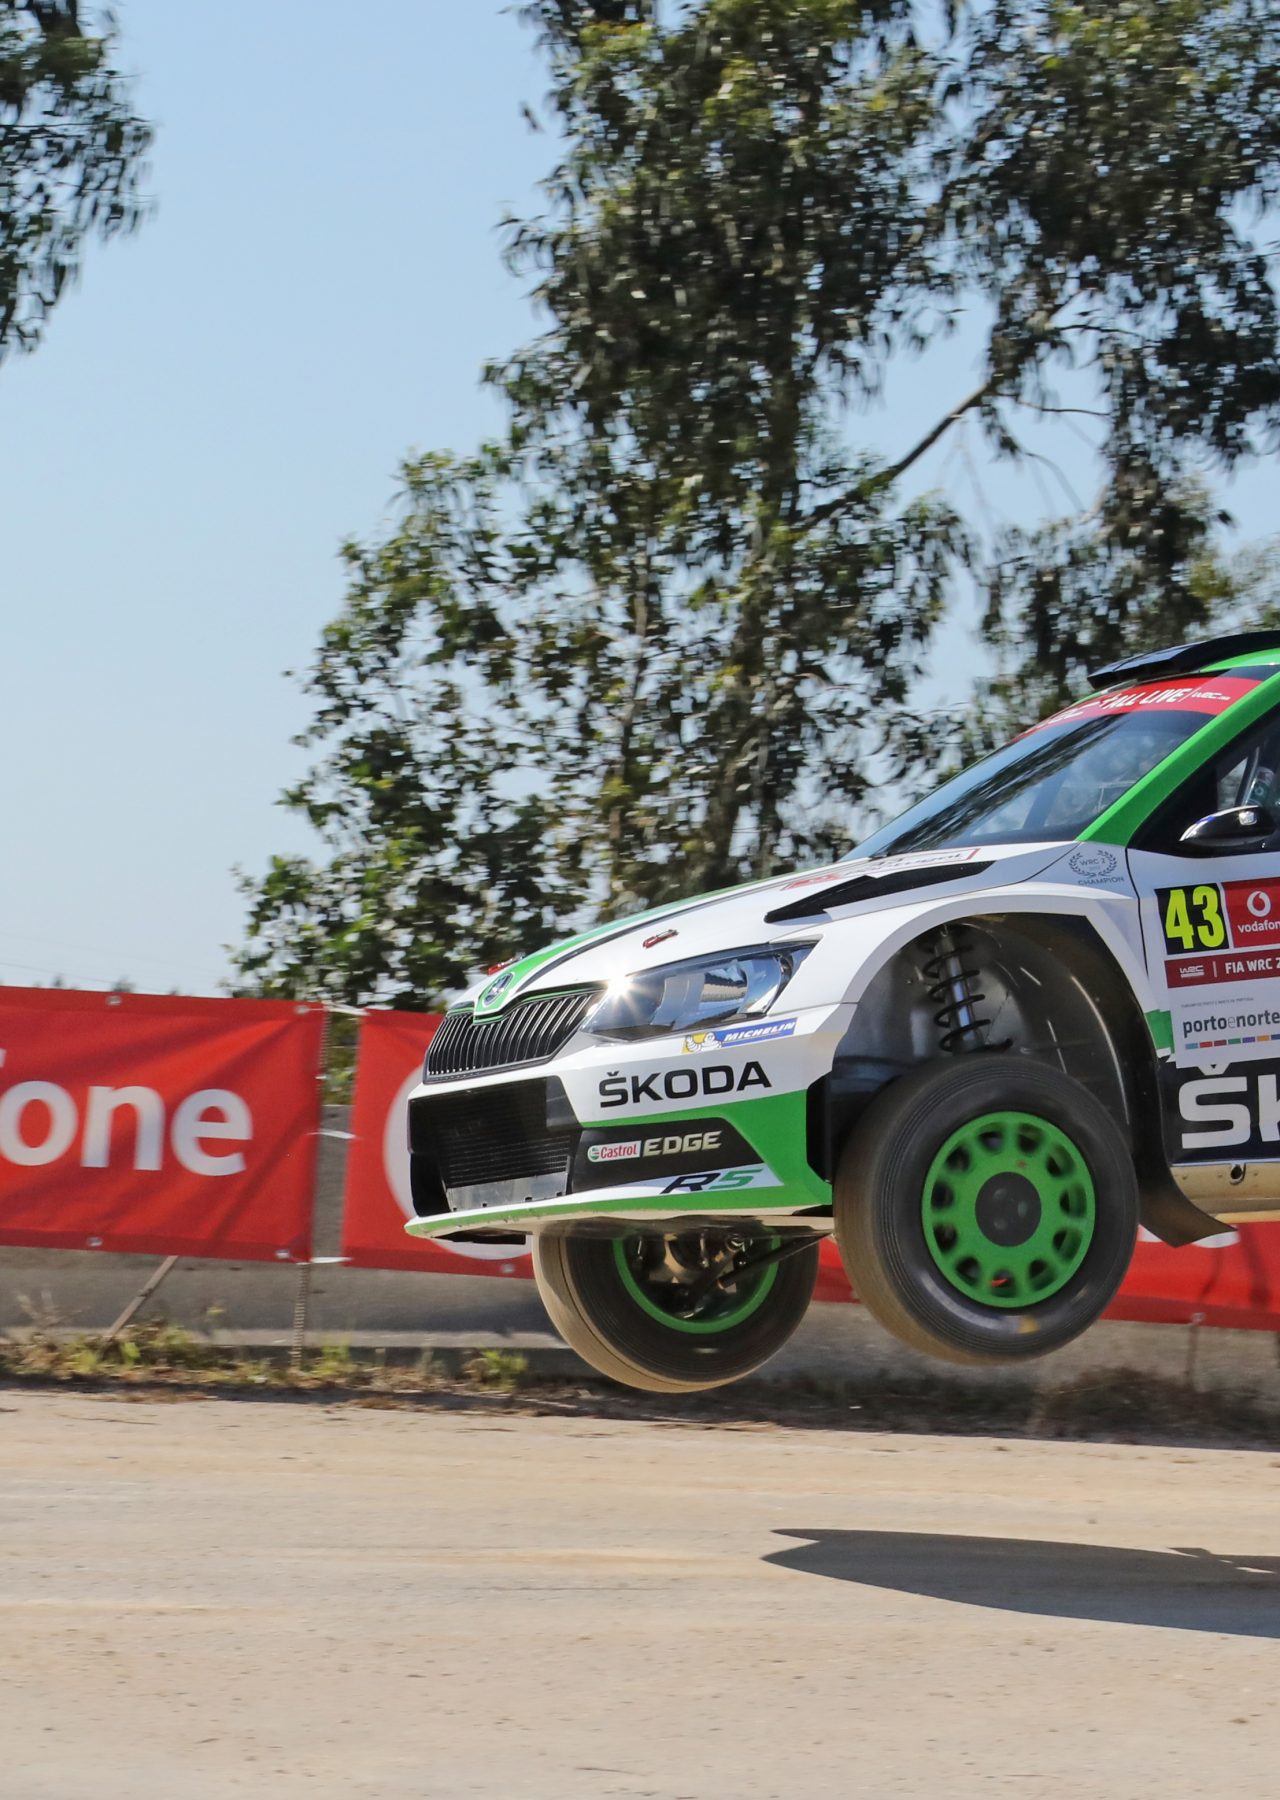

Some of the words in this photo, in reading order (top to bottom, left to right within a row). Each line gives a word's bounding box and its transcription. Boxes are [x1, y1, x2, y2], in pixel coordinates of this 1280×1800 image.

[1139, 688, 1193, 705] LIVE
[1165, 886, 1226, 949] 43
[1225, 961, 1245, 974] FIA
[1247, 958, 1273, 971] WRC
[723, 1021, 796, 1042] MICHELIN
[599, 1061, 772, 1108] ŠKODA
[0, 1047, 253, 1176] one
[600, 1143, 638, 1160] Castrol
[642, 1130, 722, 1158] EDGE
[659, 1168, 764, 1194] R5
